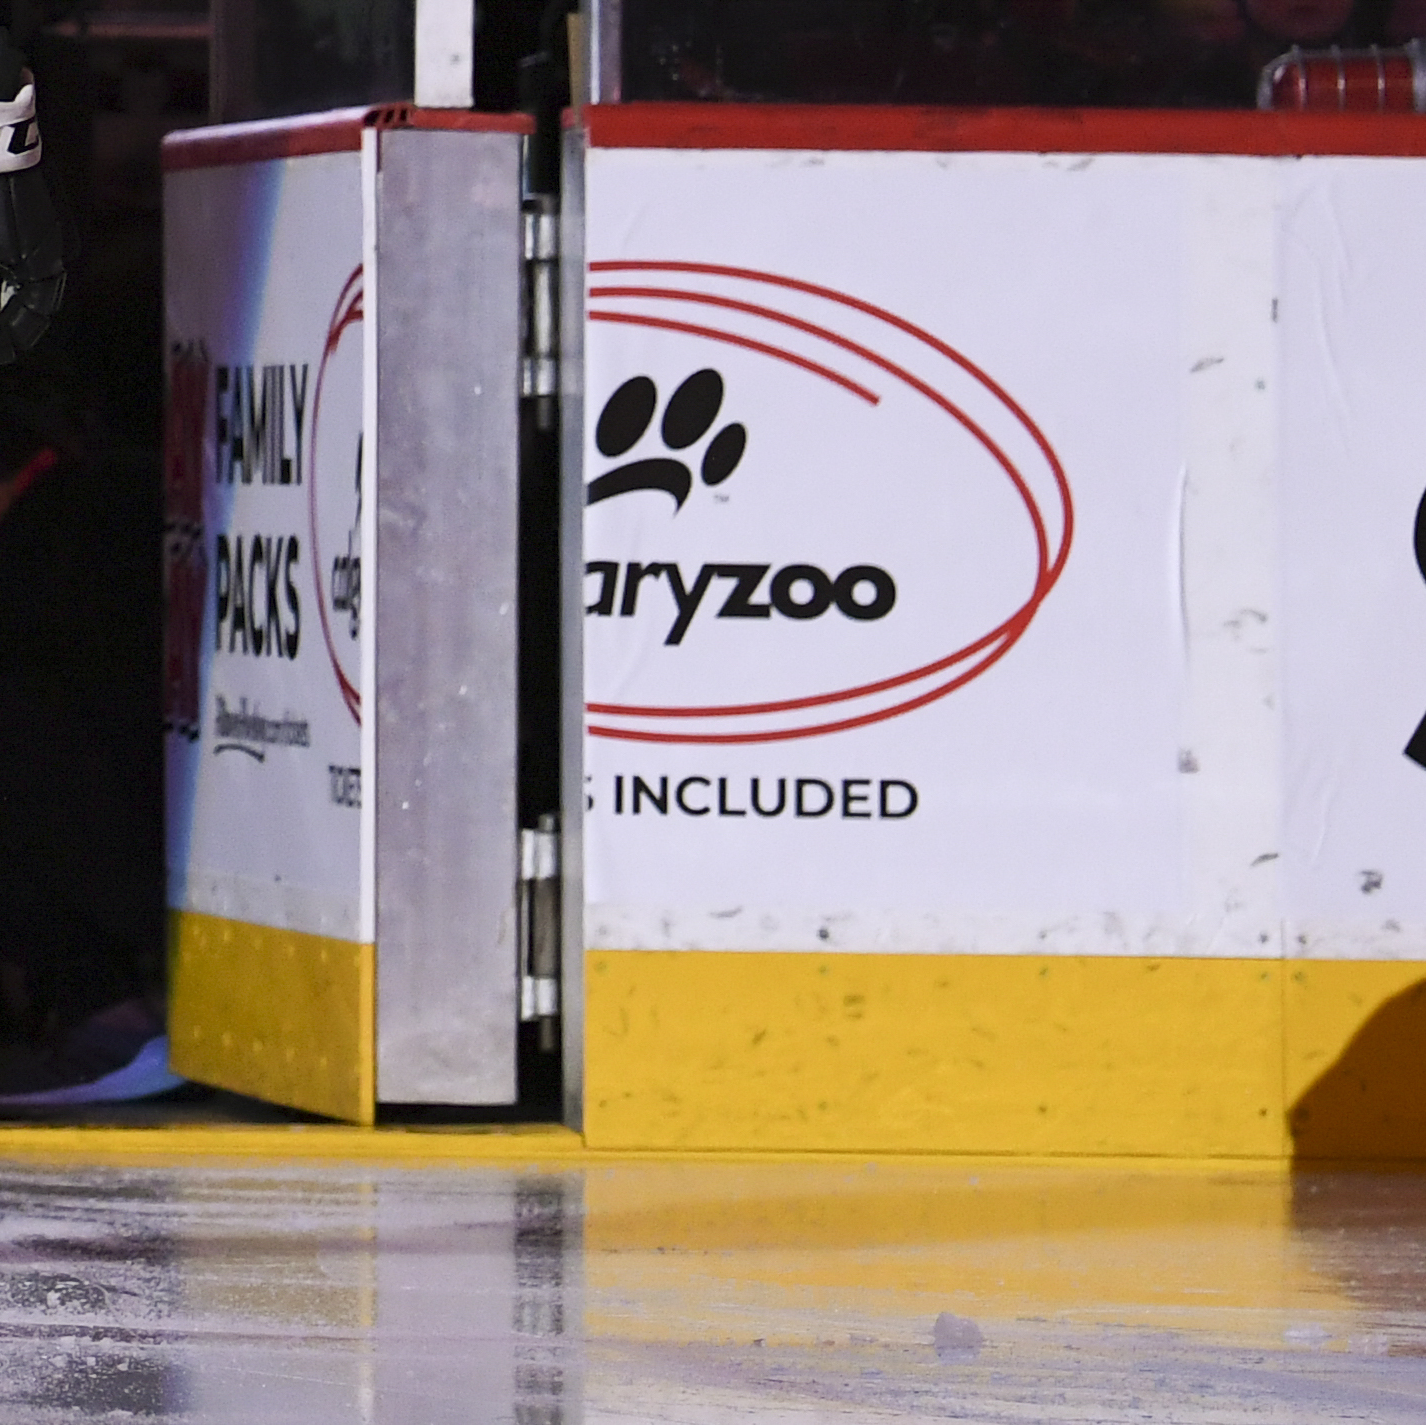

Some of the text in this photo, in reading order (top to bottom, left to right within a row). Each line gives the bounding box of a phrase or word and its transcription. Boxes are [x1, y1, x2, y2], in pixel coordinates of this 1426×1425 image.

[214, 363, 309, 486] FAMILY
[214, 533, 301, 660] PACKS
[613, 774, 920, 820] INCLUDED
